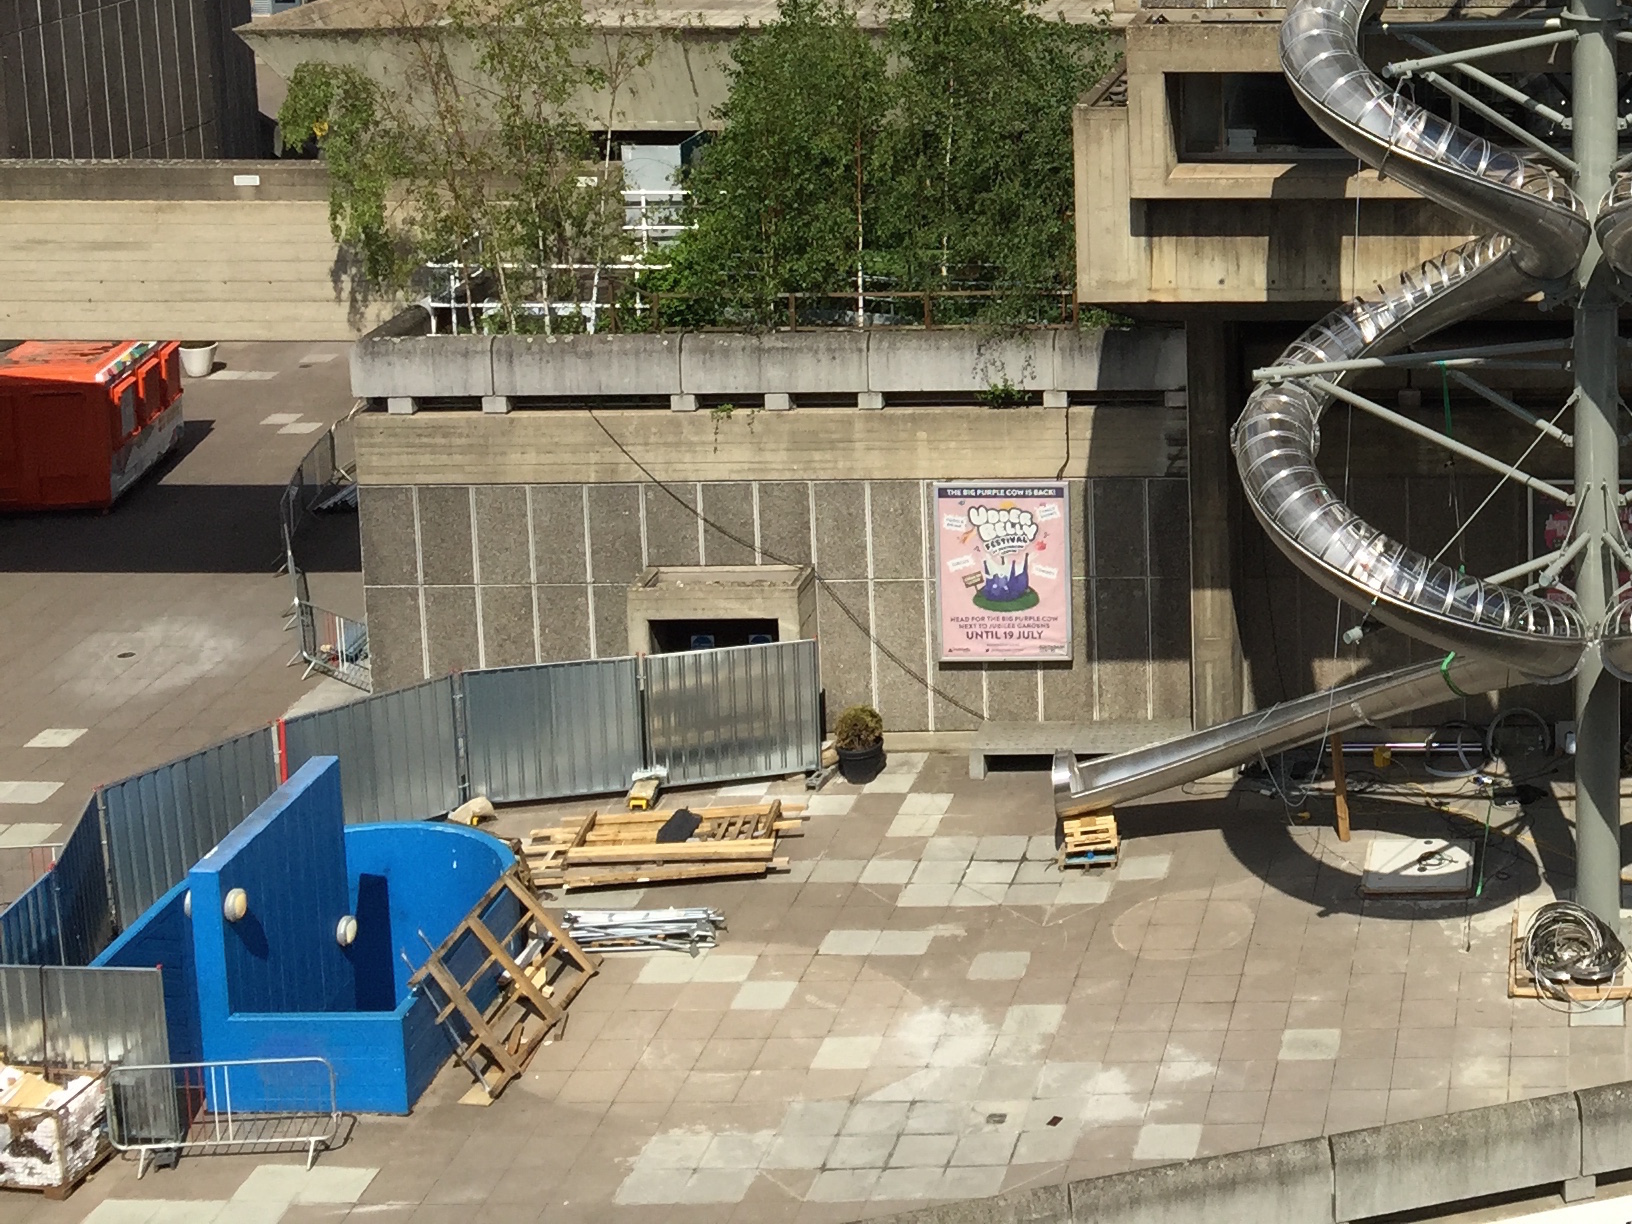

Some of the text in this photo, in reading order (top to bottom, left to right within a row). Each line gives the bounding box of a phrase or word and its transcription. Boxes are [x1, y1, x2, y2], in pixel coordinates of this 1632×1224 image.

[947, 489, 1056, 497] THE BIG PURPLE COW IS BACK!
[968, 505, 1033, 526] UDDER
[979, 521, 1038, 541] BELLY
[985, 535, 1028, 550] FESTIVAL
[966, 630, 1044, 640] UNTIL 19 JULY
